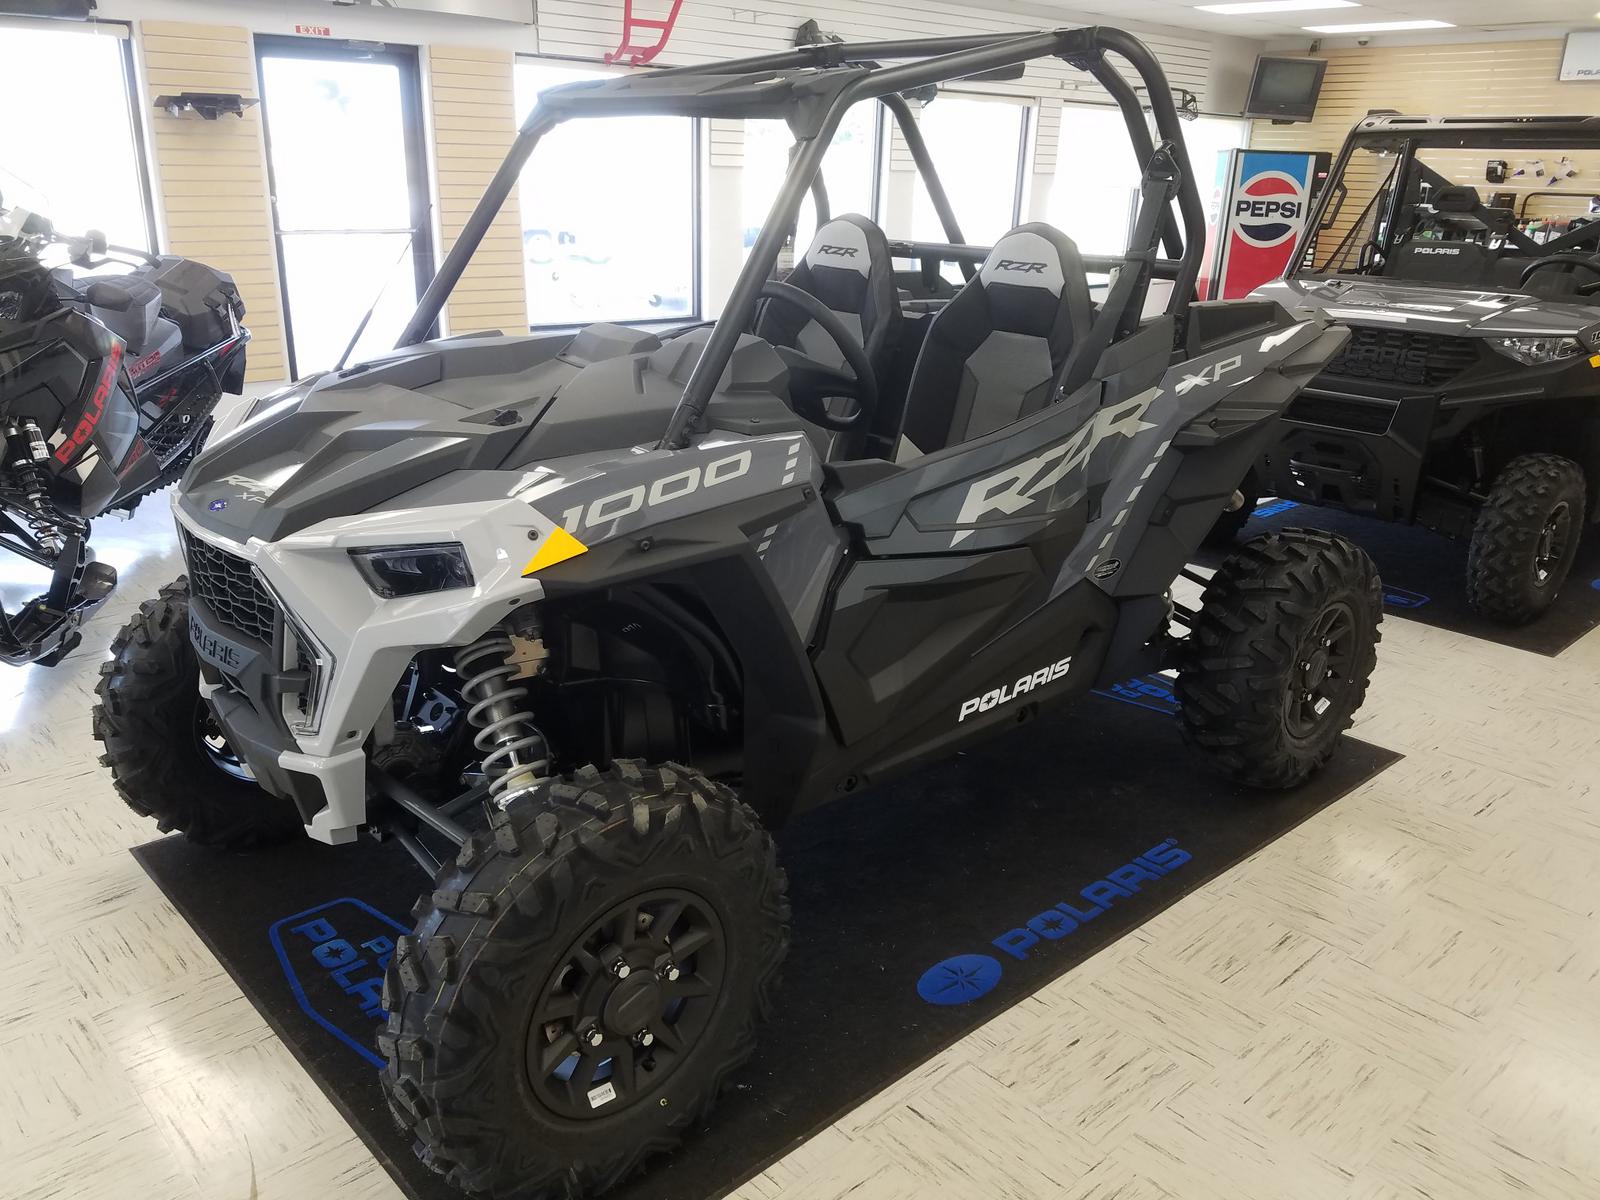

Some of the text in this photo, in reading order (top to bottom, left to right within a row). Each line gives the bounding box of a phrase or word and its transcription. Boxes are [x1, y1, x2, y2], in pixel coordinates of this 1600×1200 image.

[300, 25, 325, 36] EXIT
[1235, 200, 1302, 219] PEPSI
[817, 245, 859, 258] RZR
[994, 259, 1048, 274] RZR
[1414, 247, 1461, 255] POLARIS
[1175, 354, 1242, 397] XP
[55, 341, 122, 465] POLARIS
[949, 386, 1165, 549] RZR
[562, 449, 752, 535] 1000
[190, 615, 241, 670] POLARIS
[958, 656, 1072, 722] POLARIS
